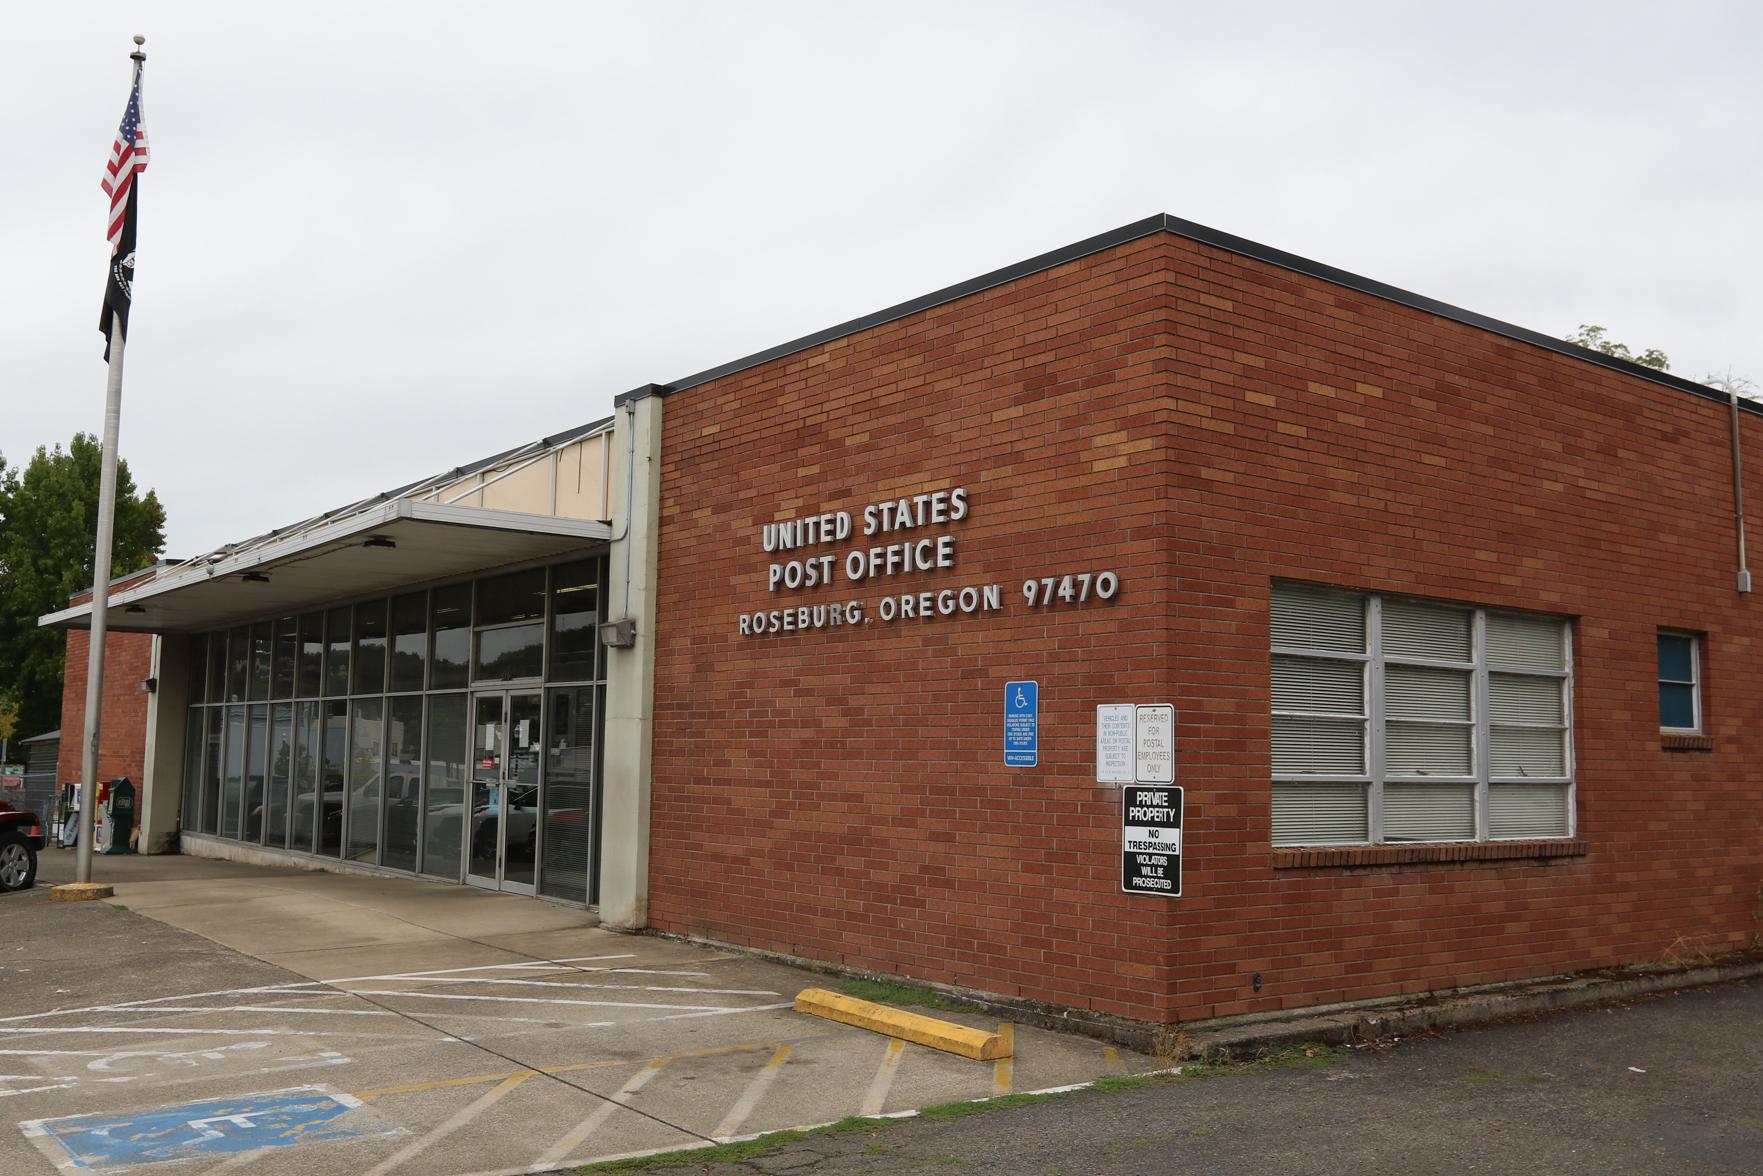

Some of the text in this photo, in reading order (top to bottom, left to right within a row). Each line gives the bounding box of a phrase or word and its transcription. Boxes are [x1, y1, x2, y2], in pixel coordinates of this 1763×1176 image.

[763, 488, 967, 552] UNITED STATES
[768, 536, 955, 591] POST OFFICE
[879, 585, 1002, 622] OREGON
[1023, 571, 1118, 606] 97470
[1139, 713, 1168, 722] RESERVED
[1148, 726, 1160, 735] FOR
[1143, 738, 1164, 748] POSTAL
[1137, 751, 1171, 761] EMPLOYEES
[1146, 763, 1160, 773] ONLY
[1136, 791, 1168, 806] PRIVATE
[1129, 806, 1176, 822] PROPERTY
[1148, 829, 1159, 839] NO
[1128, 840, 1176, 852] TRESPASSING
[1136, 854, 1168, 866] VIOLATORS
[1141, 866, 1164, 877] WILL BE
[1132, 877, 1172, 889] PROSECUTED
